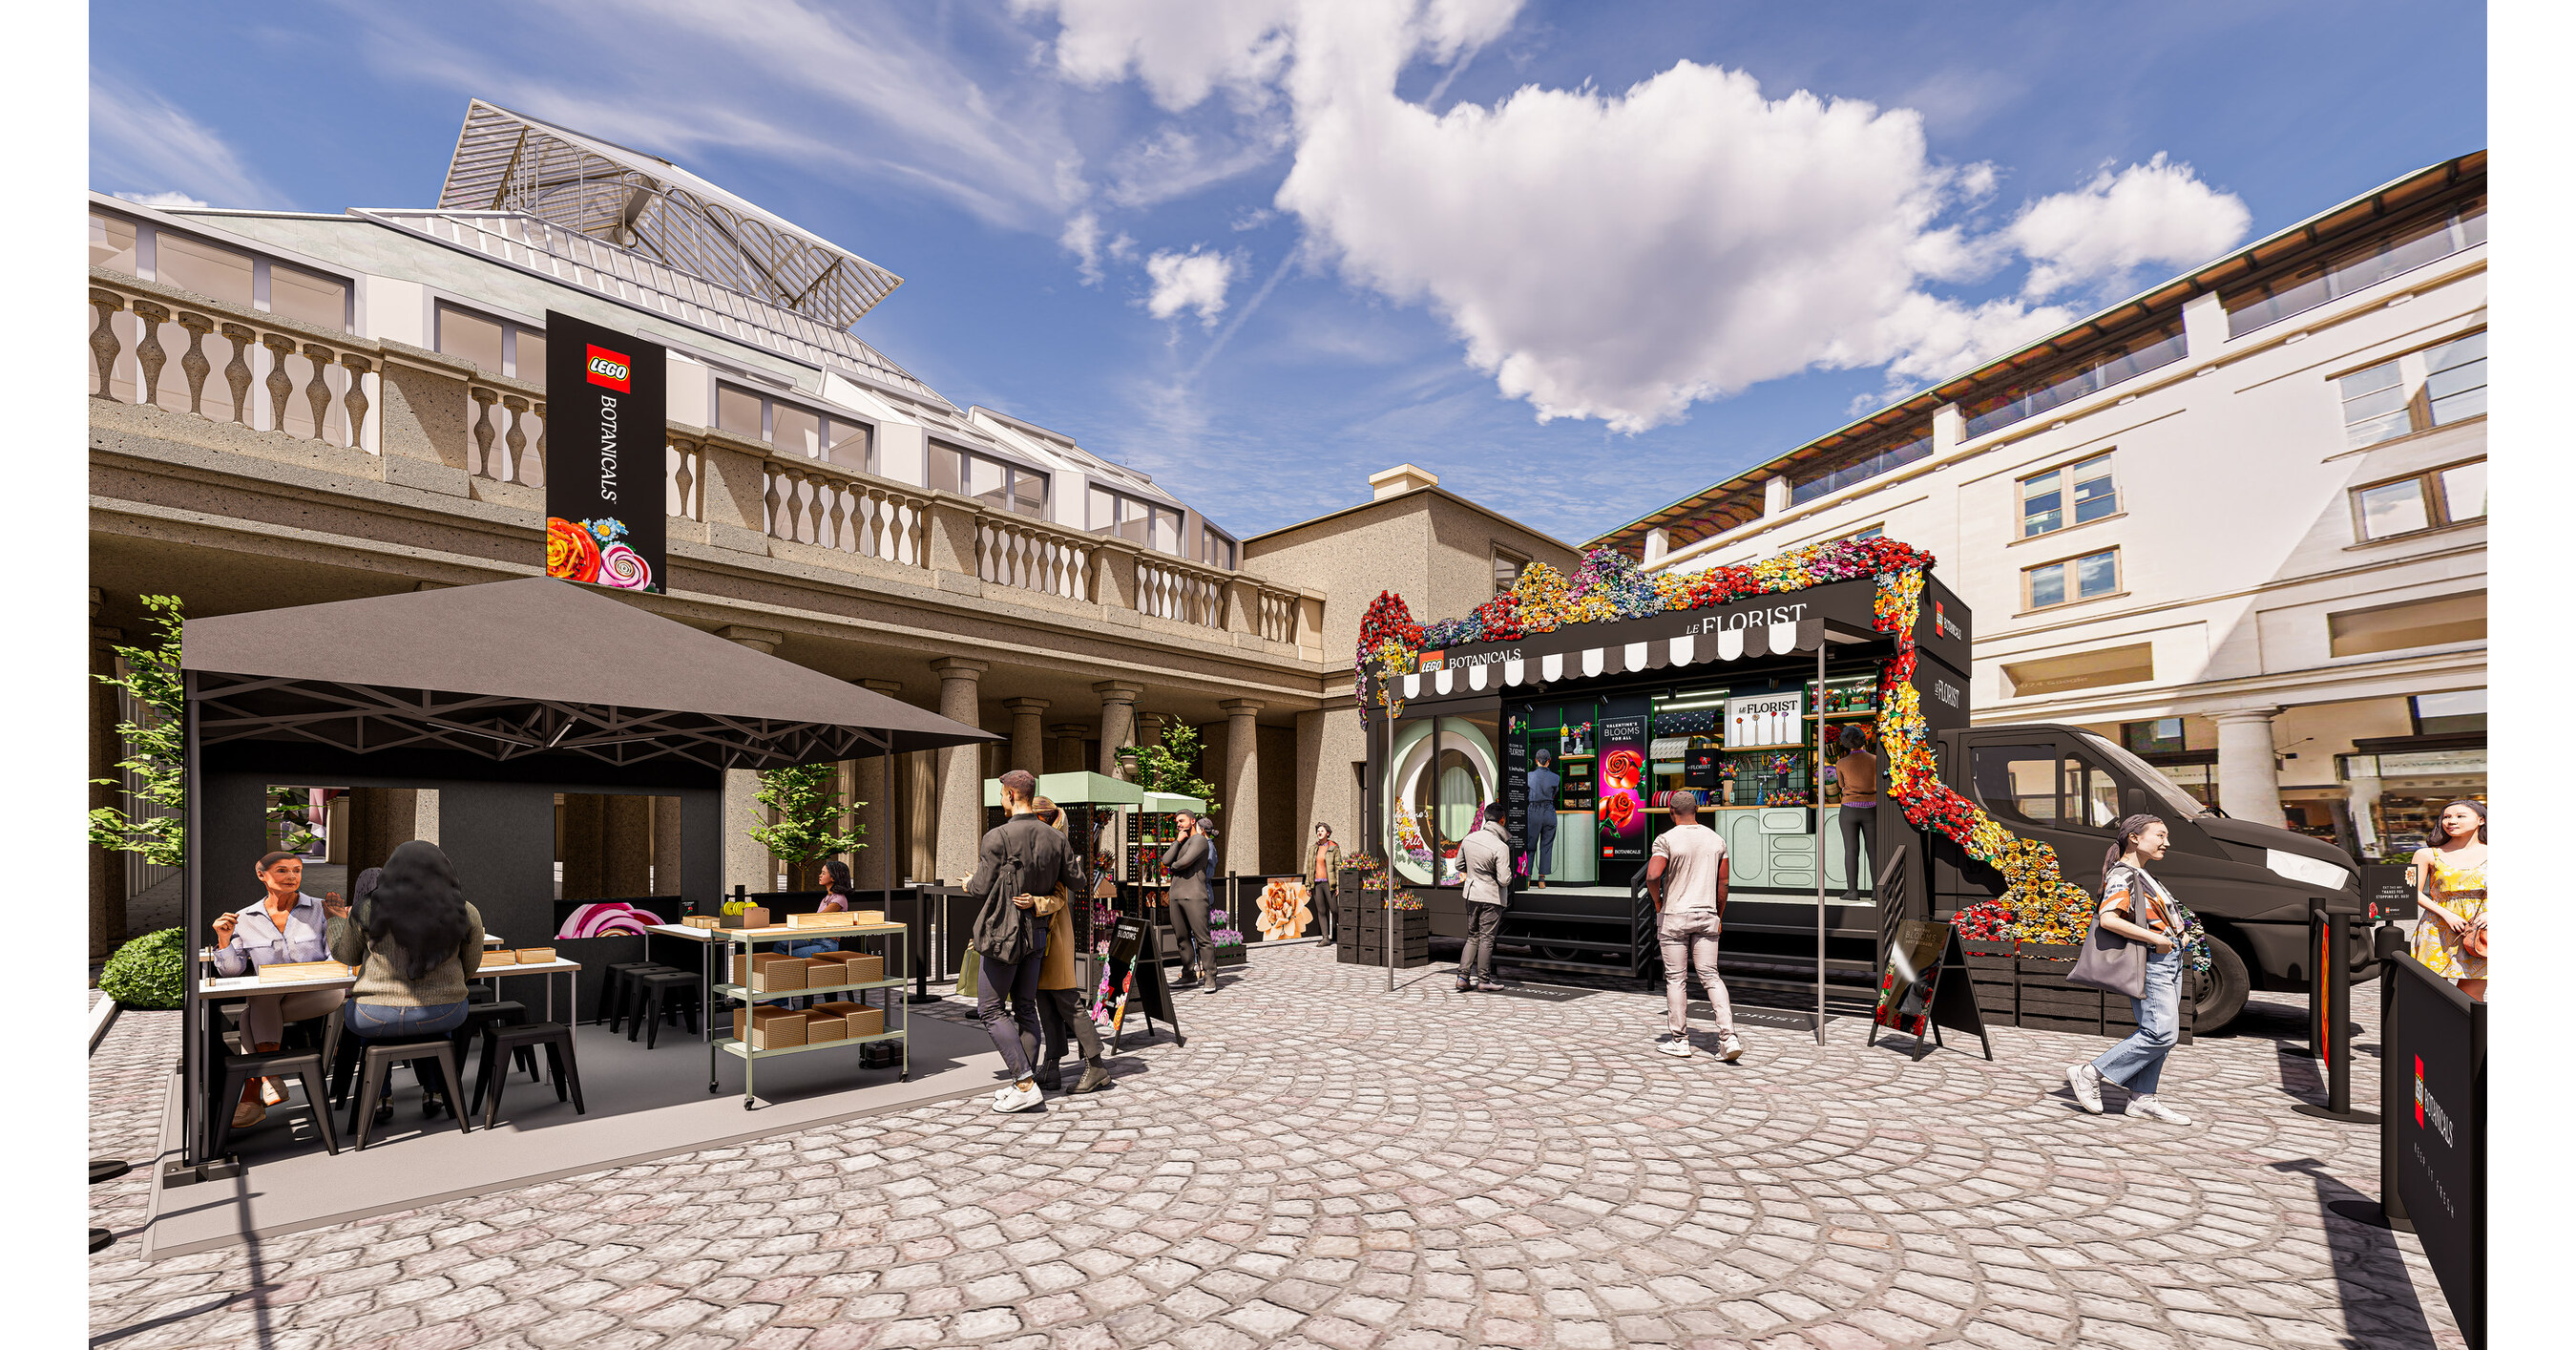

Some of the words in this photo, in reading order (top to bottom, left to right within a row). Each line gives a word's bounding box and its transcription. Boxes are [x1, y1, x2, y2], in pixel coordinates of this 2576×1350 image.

[588, 356, 629, 381] LEGO
[1686, 623, 1700, 635] LE
[1703, 603, 1807, 635] FLORIST
[1420, 659, 1442, 673] LEGO
[1449, 648, 1521, 669] BOTANICALS
[1938, 679, 1959, 708] FLORIST
[1747, 700, 1798, 714] FLORIST
[1603, 727, 1640, 737] BLOOMS
[1117, 930, 1137, 940] BLOOMS
[1905, 930, 1937, 942] BLOOMS
[2436, 1180, 2455, 1219] FRESH
